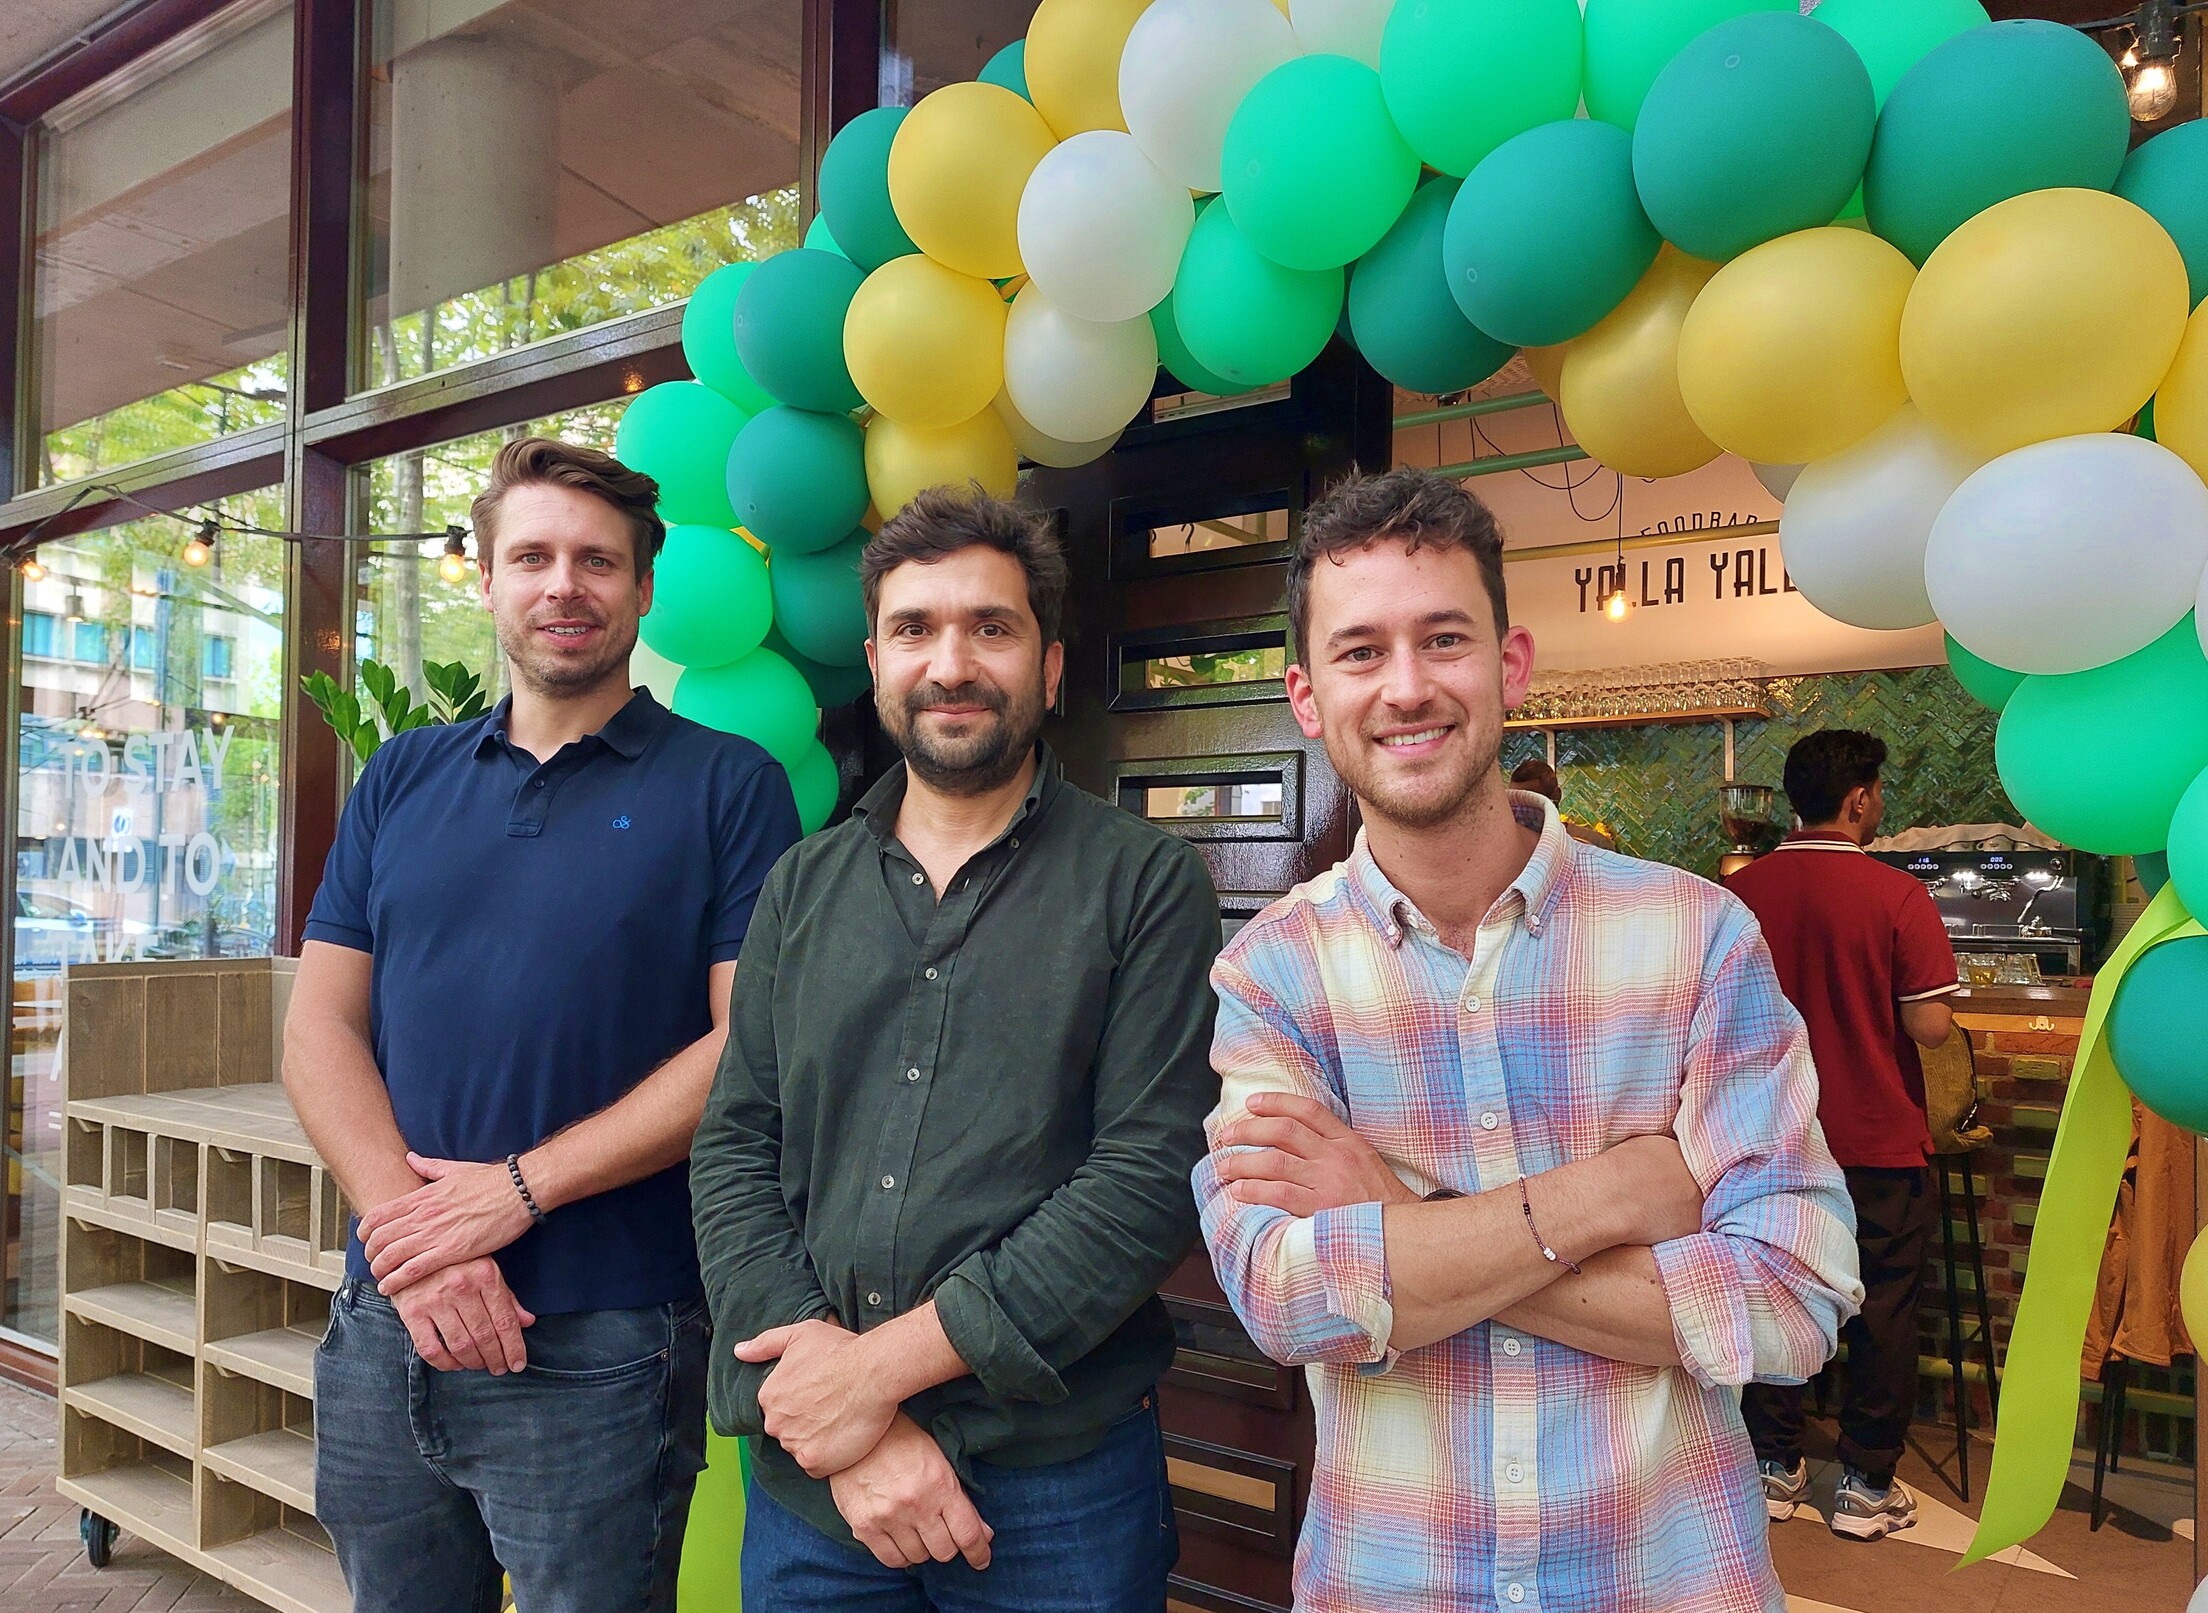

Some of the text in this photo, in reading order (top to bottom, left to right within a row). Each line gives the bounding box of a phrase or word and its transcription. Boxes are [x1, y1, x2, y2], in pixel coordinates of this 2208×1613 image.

[58, 725, 235, 798] TO STAY
[56, 831, 221, 896] AND TO
